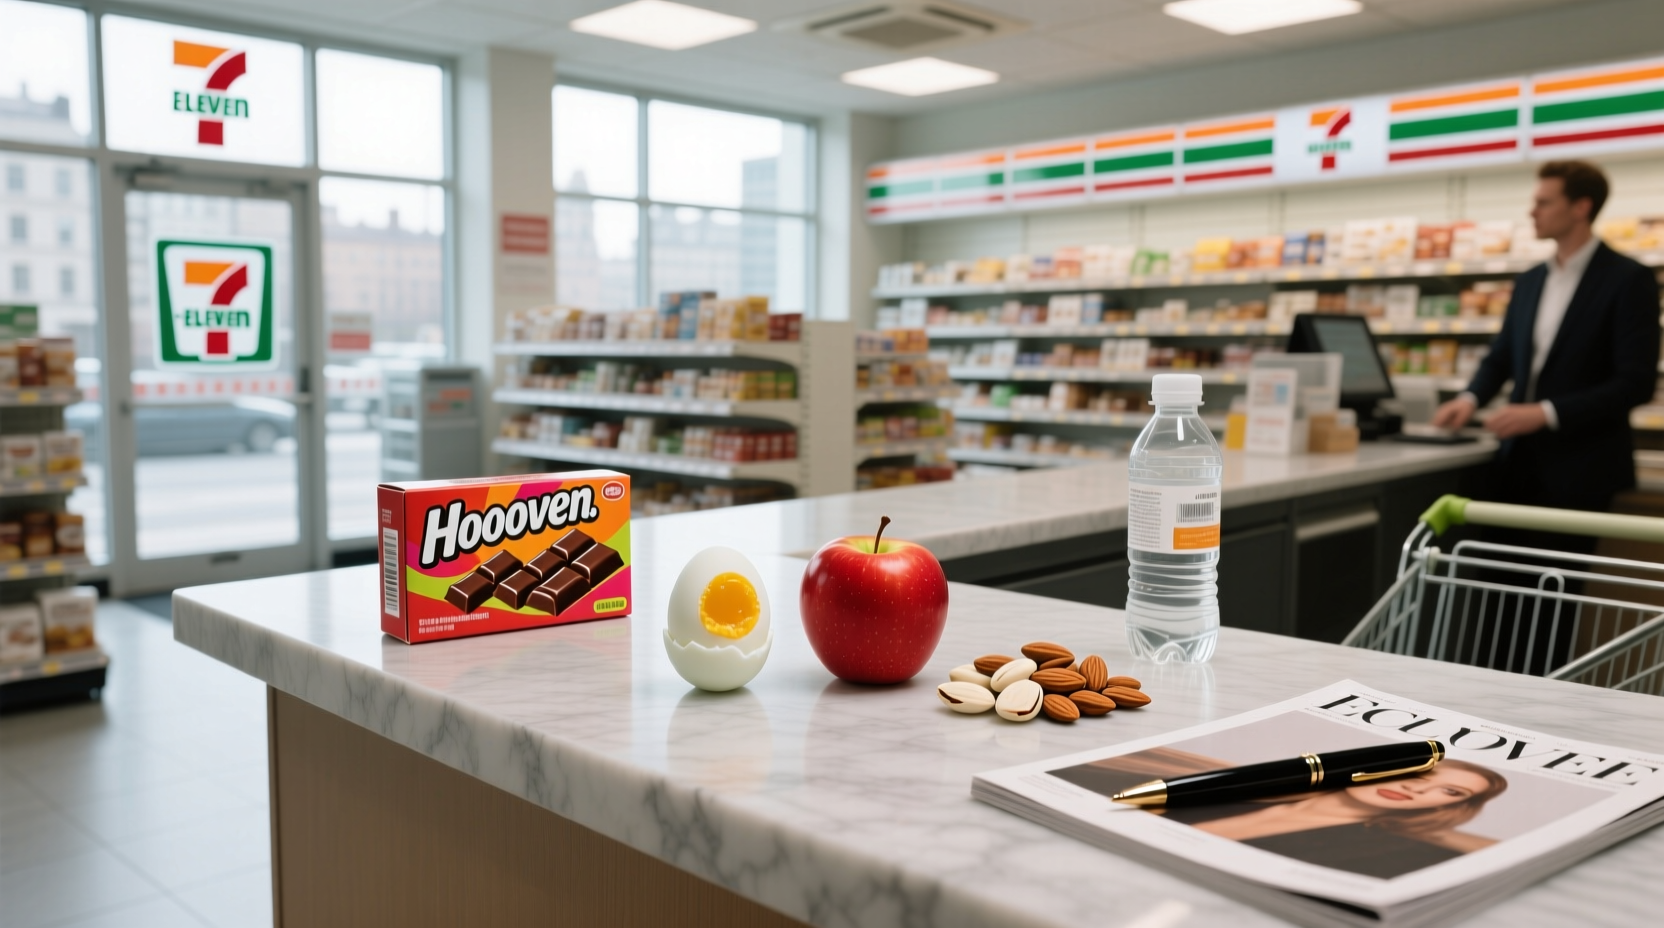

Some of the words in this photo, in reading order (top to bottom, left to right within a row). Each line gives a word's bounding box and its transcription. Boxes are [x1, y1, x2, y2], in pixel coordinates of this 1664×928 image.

[173, 40, 246, 145] 7
[184, 261, 247, 354] 7
[1315, 694, 1659, 786] ECLOVEE
